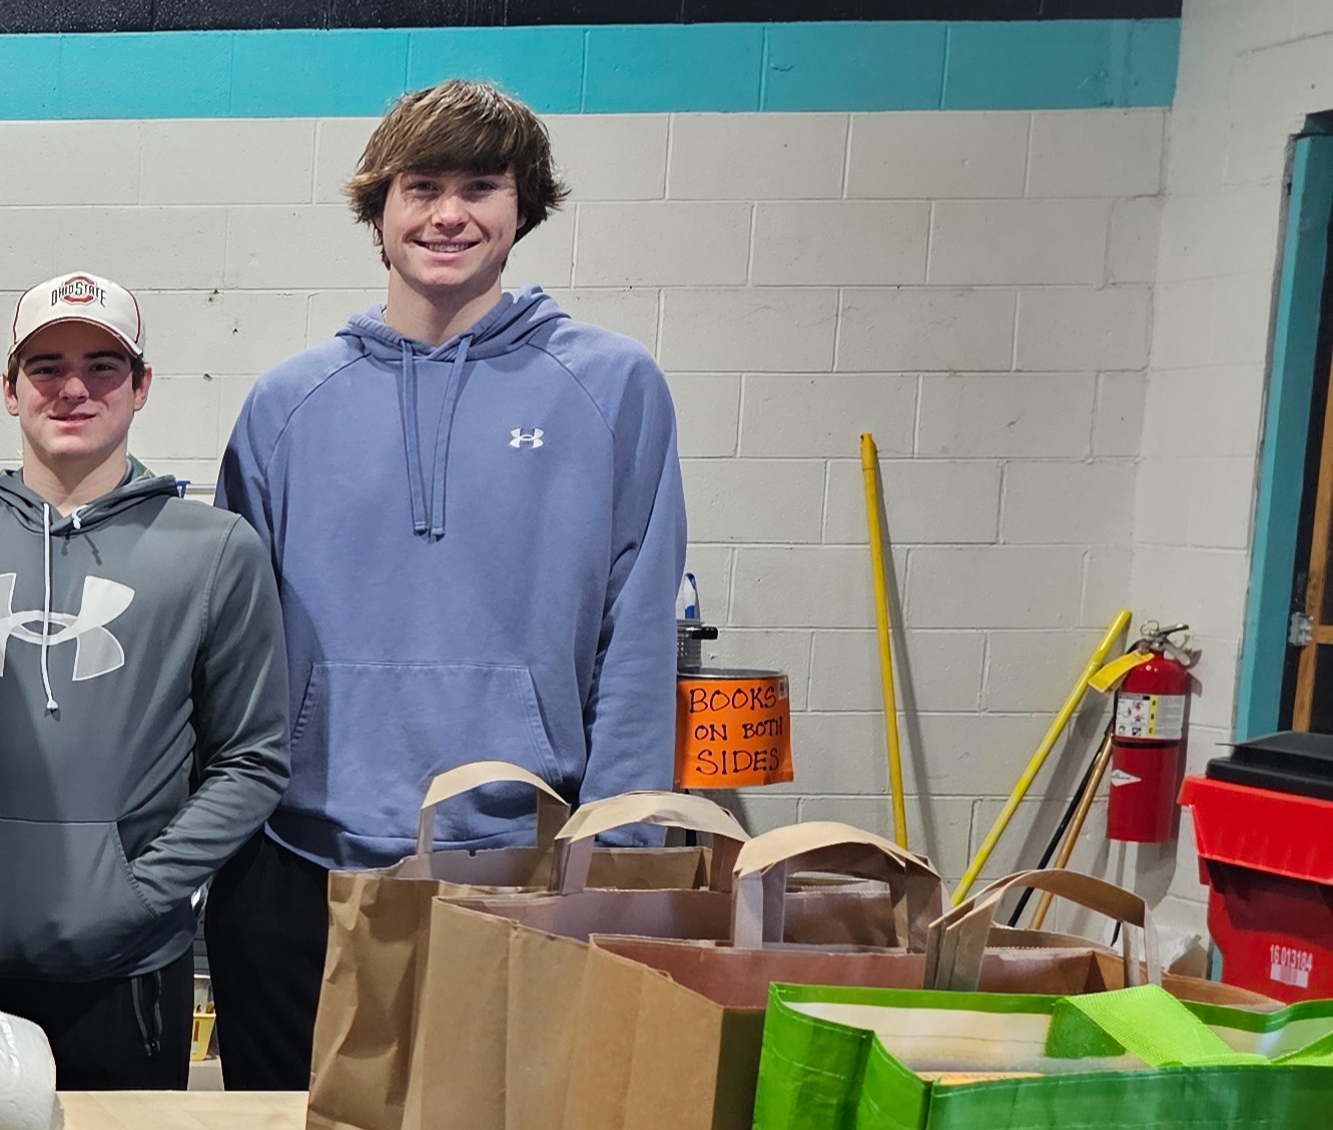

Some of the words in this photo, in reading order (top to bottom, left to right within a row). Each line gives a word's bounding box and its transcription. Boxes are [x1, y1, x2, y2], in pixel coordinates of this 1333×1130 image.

[75, 281, 107, 308] STATE
[689, 686, 776, 713] BOOKS
[695, 723, 728, 741] ON
[741, 716, 783, 739] BOTH
[696, 747, 780, 776] SIDES
